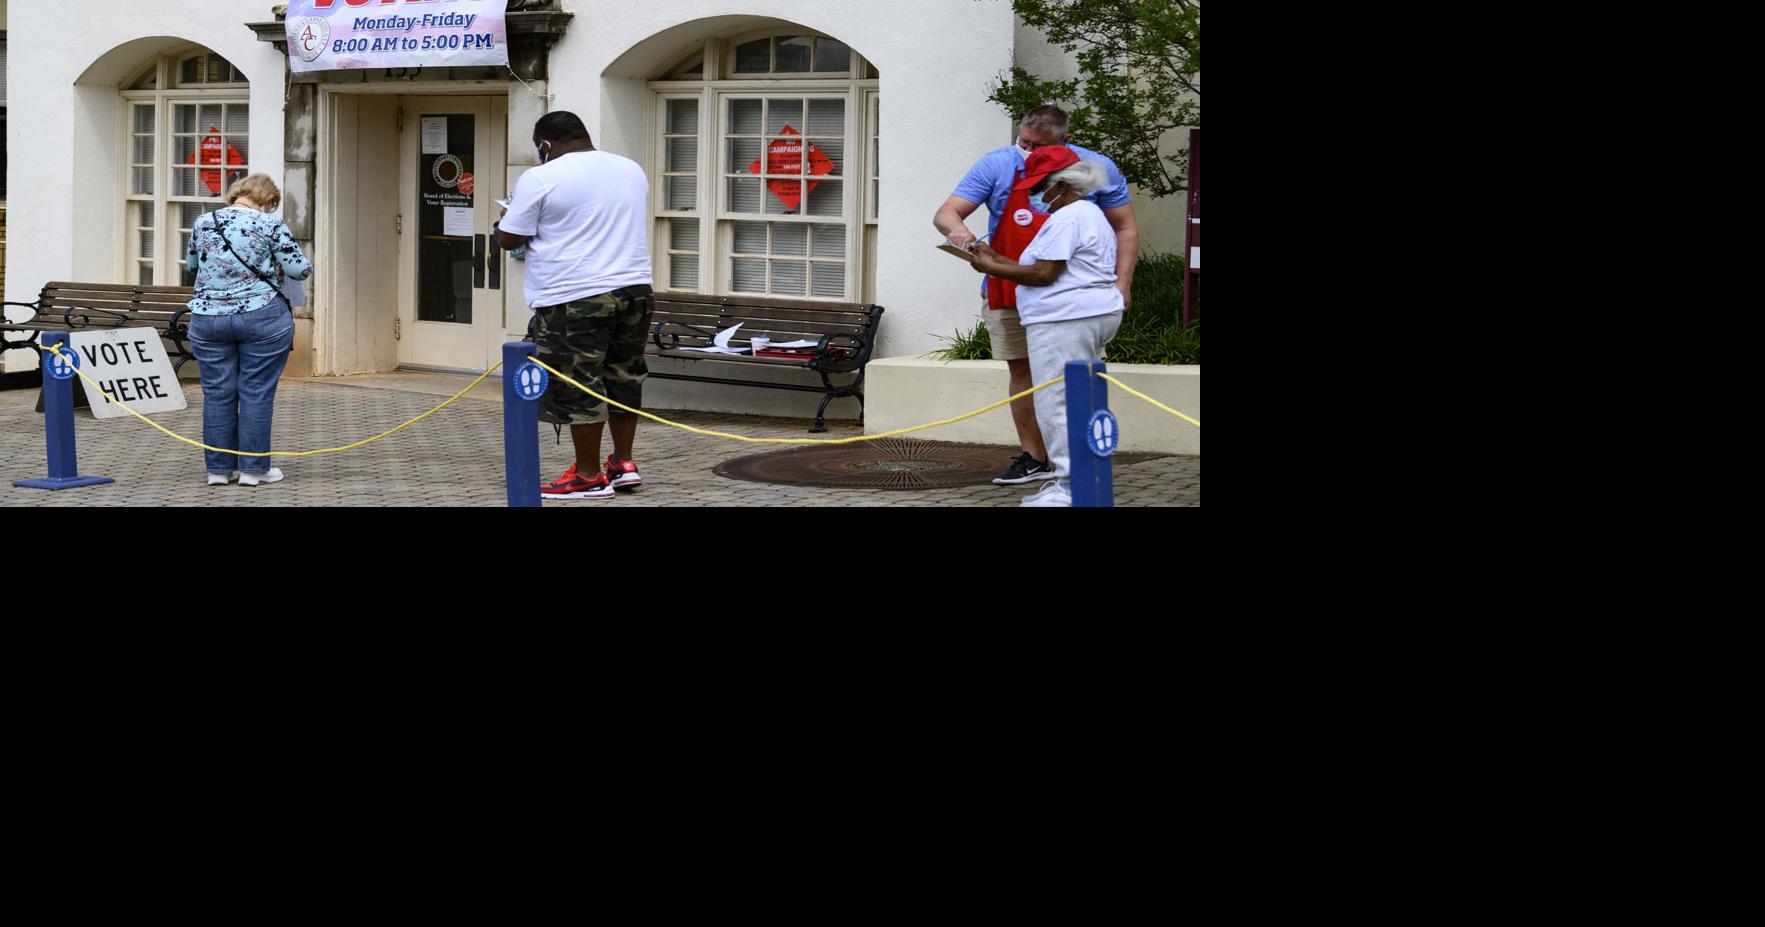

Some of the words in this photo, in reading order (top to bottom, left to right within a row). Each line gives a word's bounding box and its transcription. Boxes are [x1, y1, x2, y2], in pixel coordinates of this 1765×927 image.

[352, 13, 476, 32] Monday-Friday
[332, 38, 367, 53] 8:00
[370, 37, 398, 51] AM
[402, 36, 418, 50] to
[421, 35, 459, 49] 5:00
[462, 33, 493, 48] PM
[81, 340, 153, 367] VOTE
[99, 375, 168, 404] HERE
